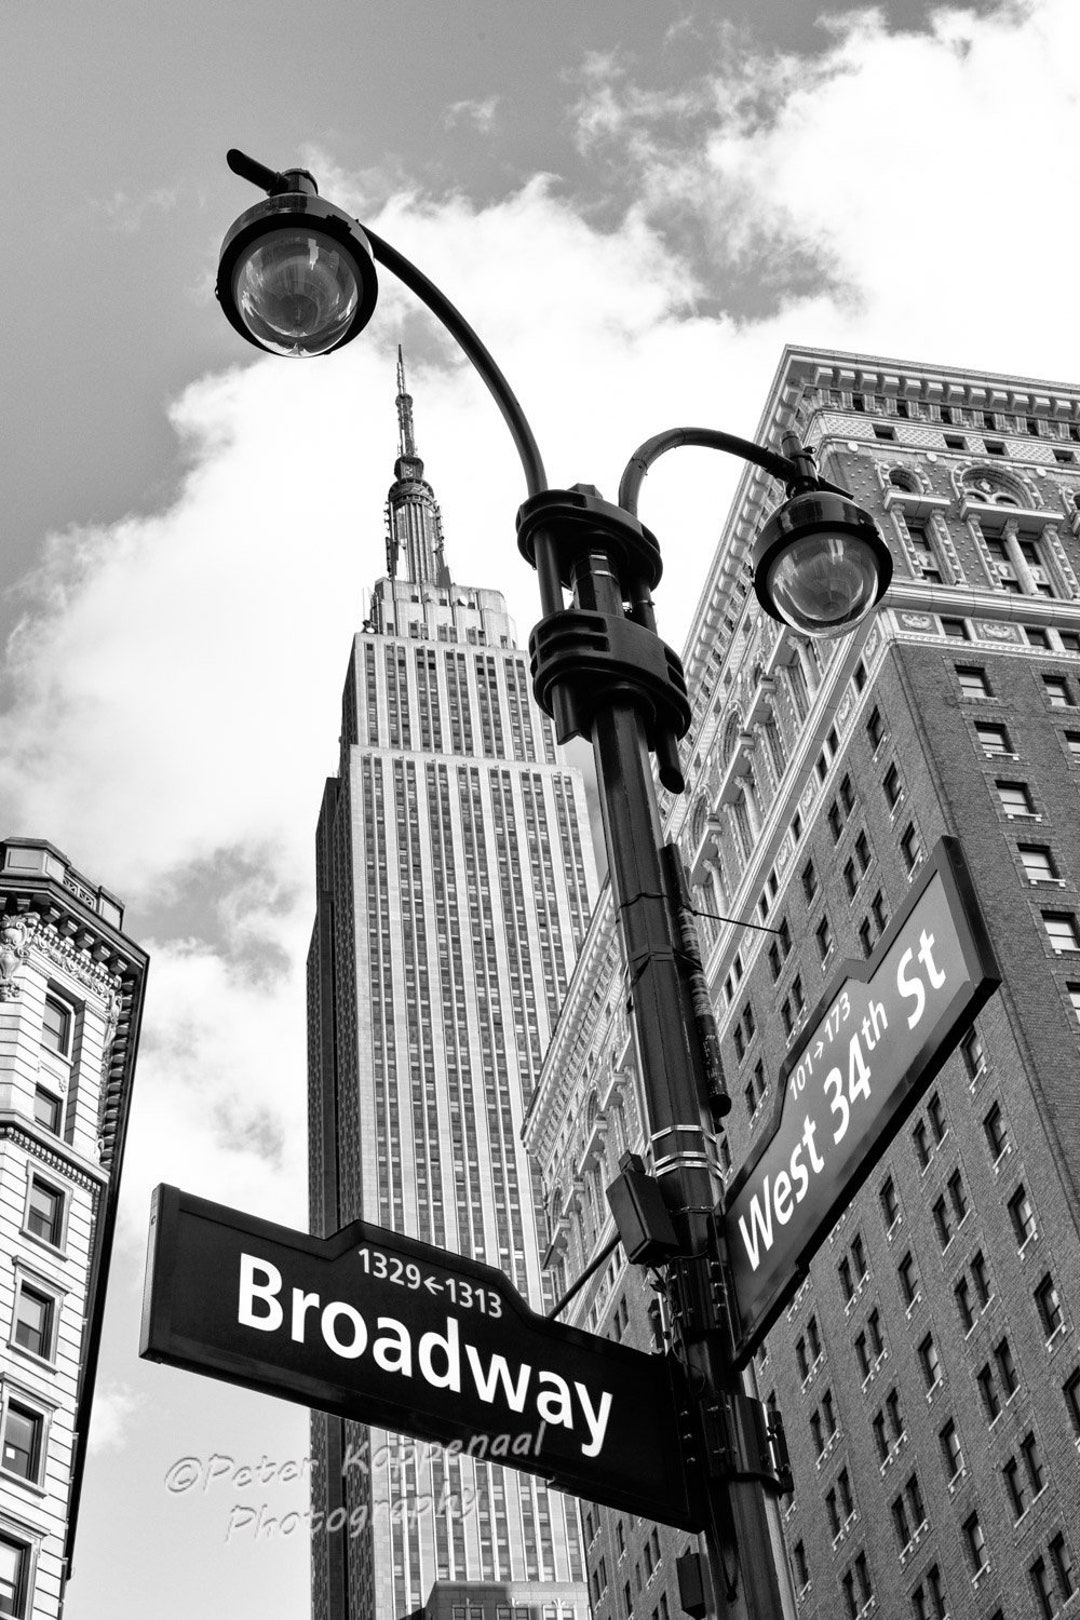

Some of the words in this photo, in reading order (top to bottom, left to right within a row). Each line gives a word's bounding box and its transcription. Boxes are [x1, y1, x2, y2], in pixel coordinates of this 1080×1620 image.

[737, 1114, 825, 1271] West
[823, 999, 889, 1146] 34th
[897, 927, 947, 1031] St
[789, 1052, 813, 1101] 101
[824, 991, 851, 1042] 173
[237, 1251, 614, 1458] Broadway
